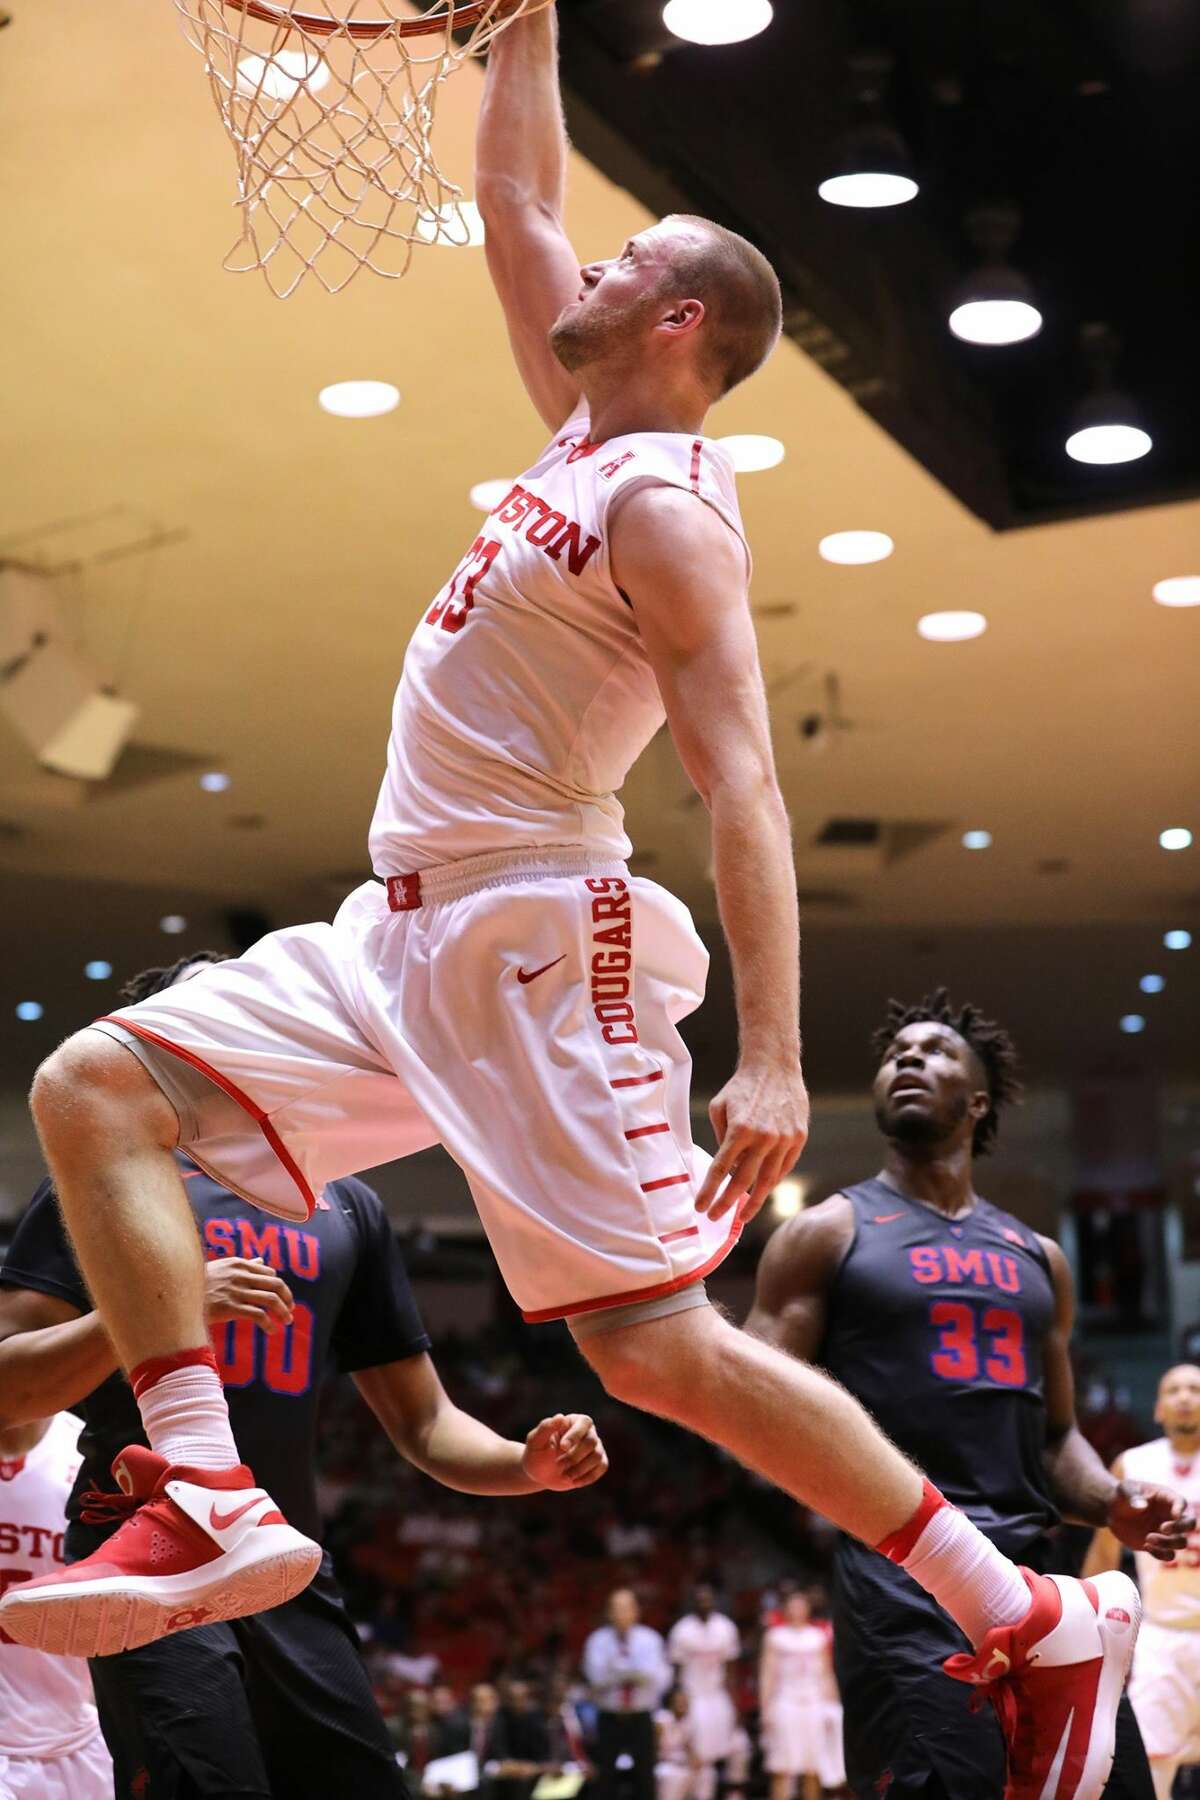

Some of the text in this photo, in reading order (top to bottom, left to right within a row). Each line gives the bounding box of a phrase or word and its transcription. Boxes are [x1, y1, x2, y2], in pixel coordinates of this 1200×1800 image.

[585, 876, 638, 1046] COUGARS
[203, 1217, 321, 1282] SMU
[909, 1246, 1022, 1295] SMU
[207, 1301, 316, 1397] 00
[929, 1300, 1028, 1388] 33
